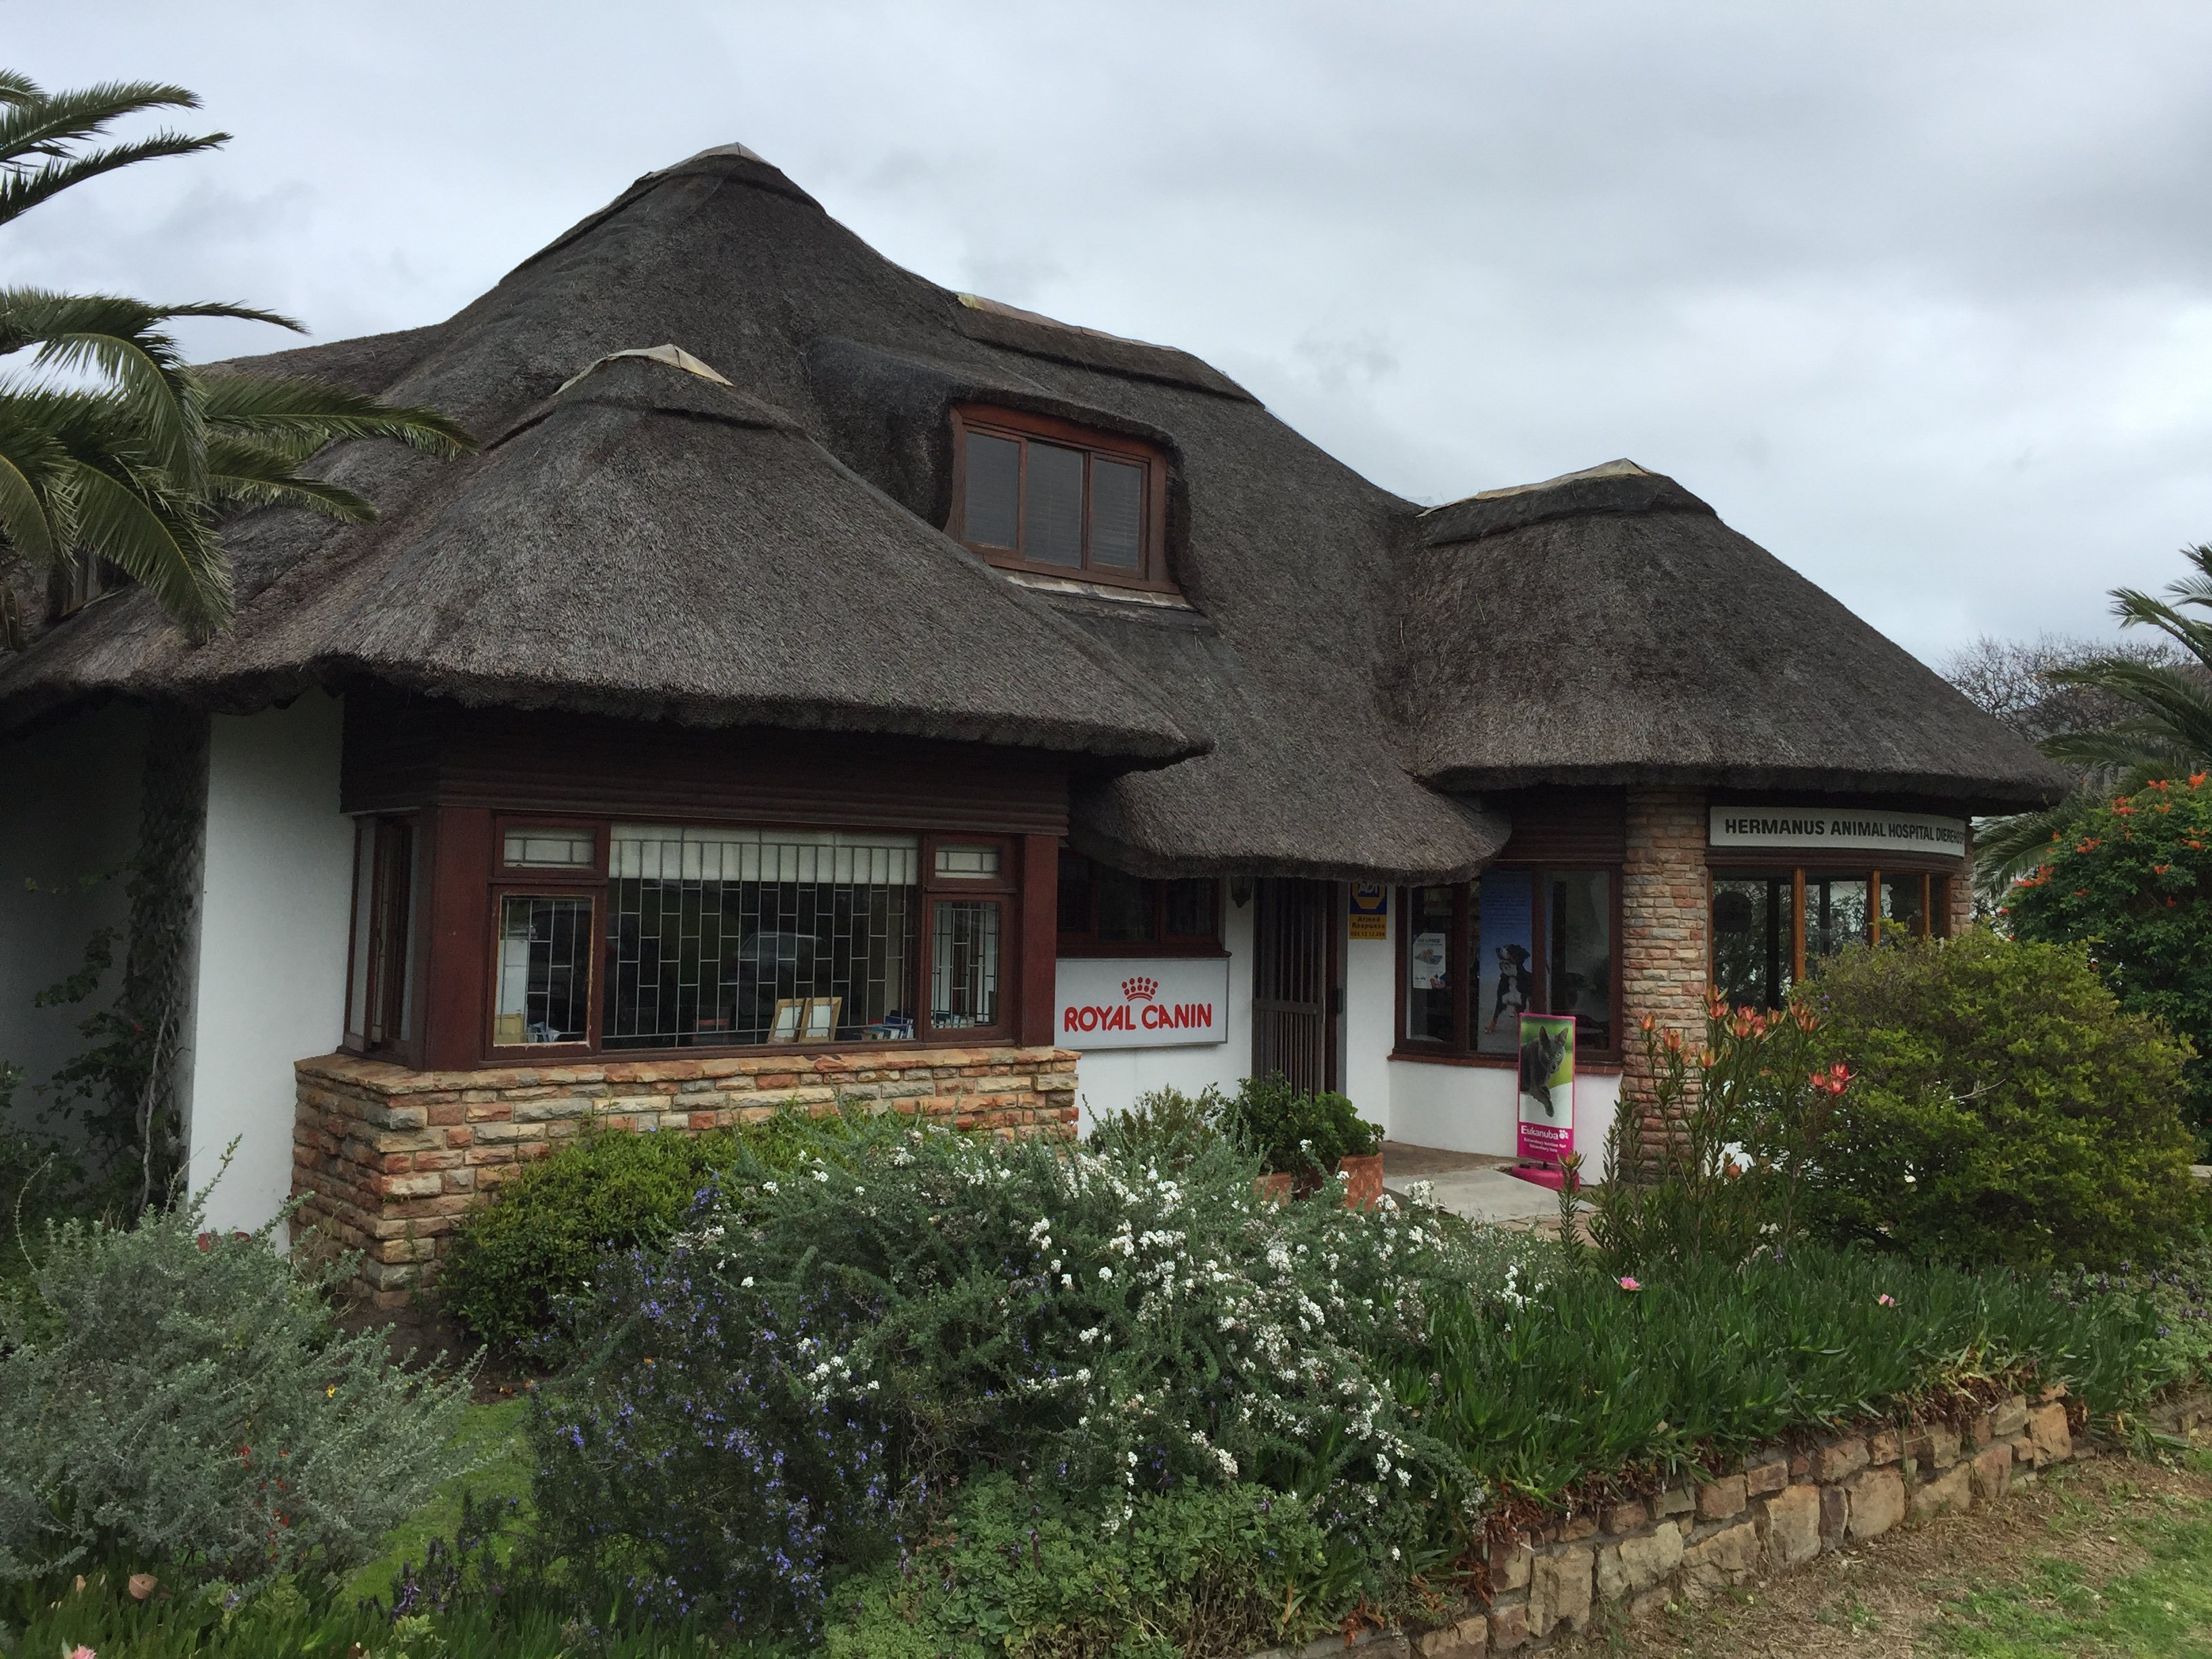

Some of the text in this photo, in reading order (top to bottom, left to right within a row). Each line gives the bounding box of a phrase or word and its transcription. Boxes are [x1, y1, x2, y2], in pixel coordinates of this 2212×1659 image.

[1725, 818, 1825, 835] HERMANUS
[1830, 820, 1885, 838] ANIMAL
[1888, 823, 1935, 841] HOSPITAL
[1064, 1004, 1212, 1032] ROYAL CANIN
[1521, 1125, 1559, 1140] Eukanuba
